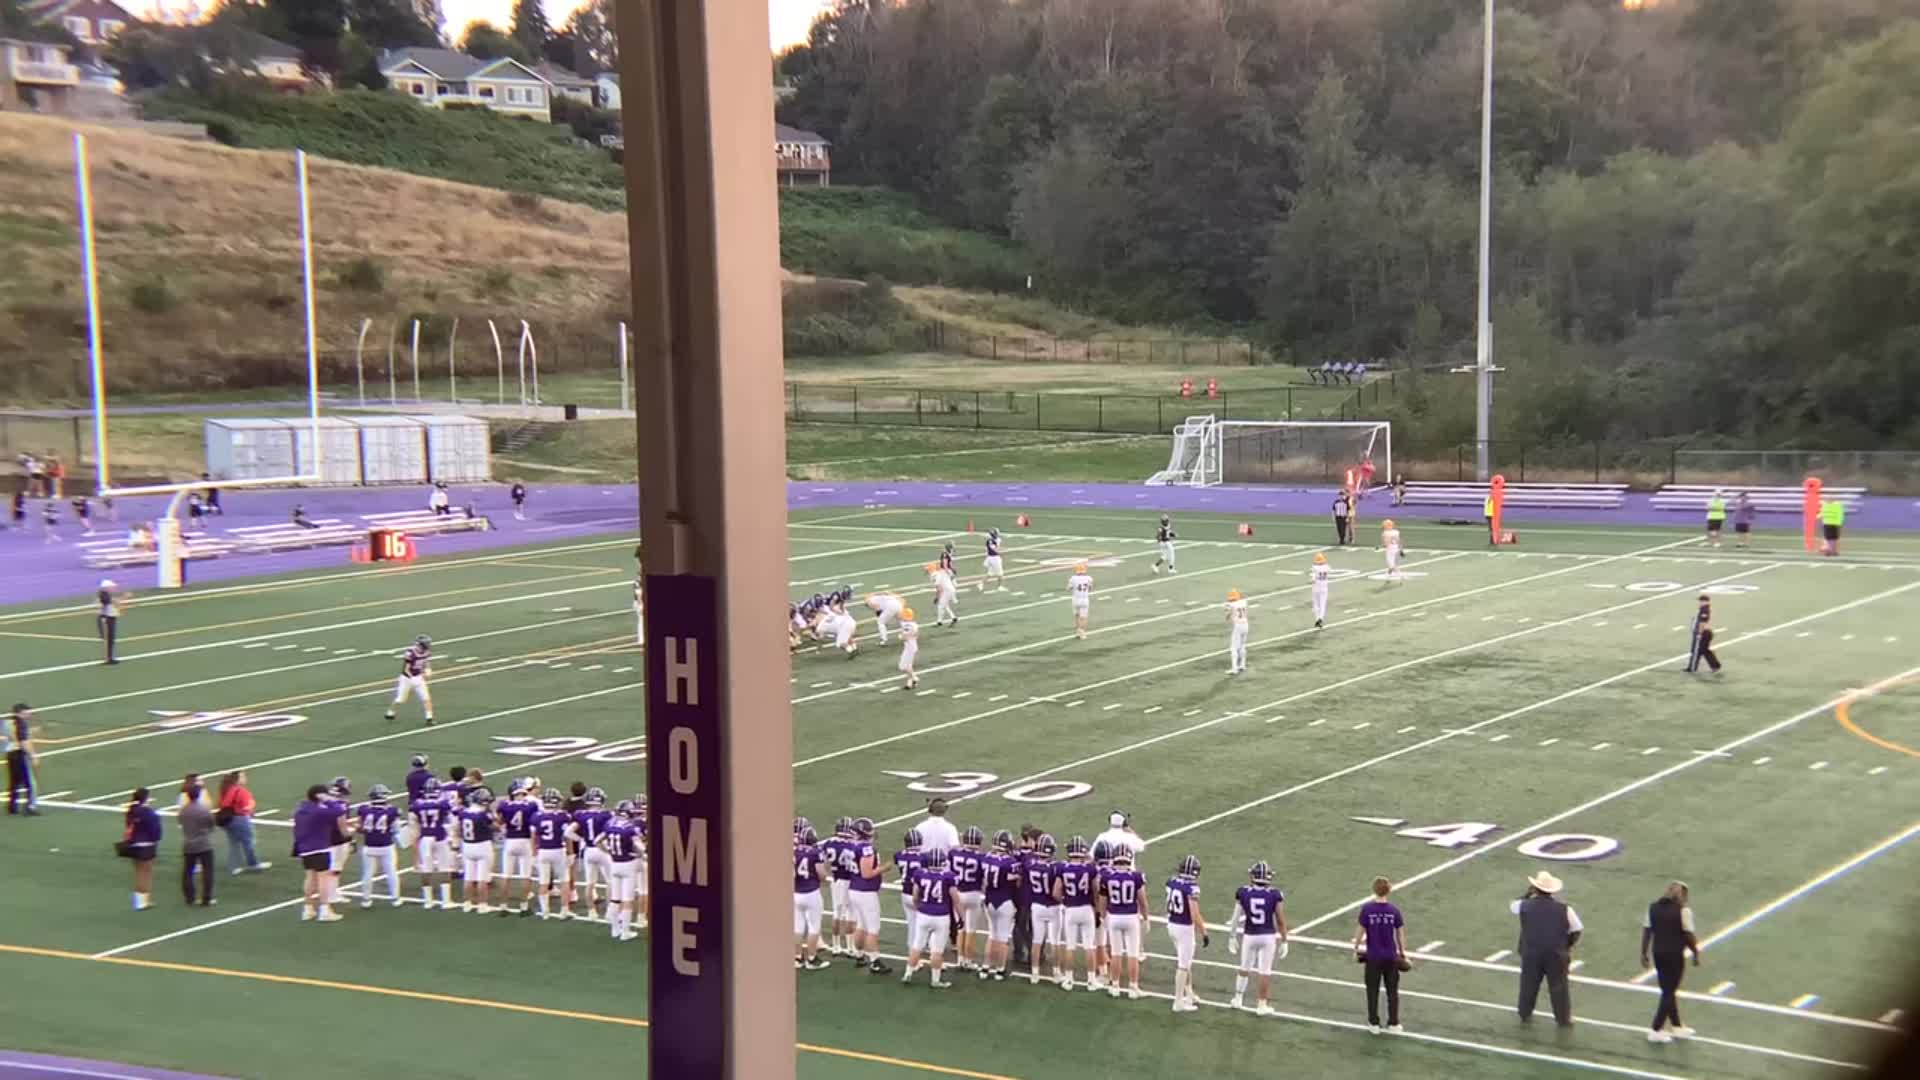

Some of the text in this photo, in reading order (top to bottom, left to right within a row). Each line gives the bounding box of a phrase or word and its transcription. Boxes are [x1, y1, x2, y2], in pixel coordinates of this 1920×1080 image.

[384, 532, 406, 558] 16
[662, 636, 709, 977] HOME
[363, 815, 388, 834] 44
[419, 810, 440, 829] 17
[463, 819, 475, 842] 8
[510, 811, 523, 832] 4
[541, 821, 554, 841] 3
[586, 818, 595, 842] 1
[953, 856, 978, 882] 52
[920, 879, 943, 904] 74
[1029, 871, 1050, 895] 51
[1063, 871, 1089, 897] 54
[1250, 898, 1265, 925] 5
